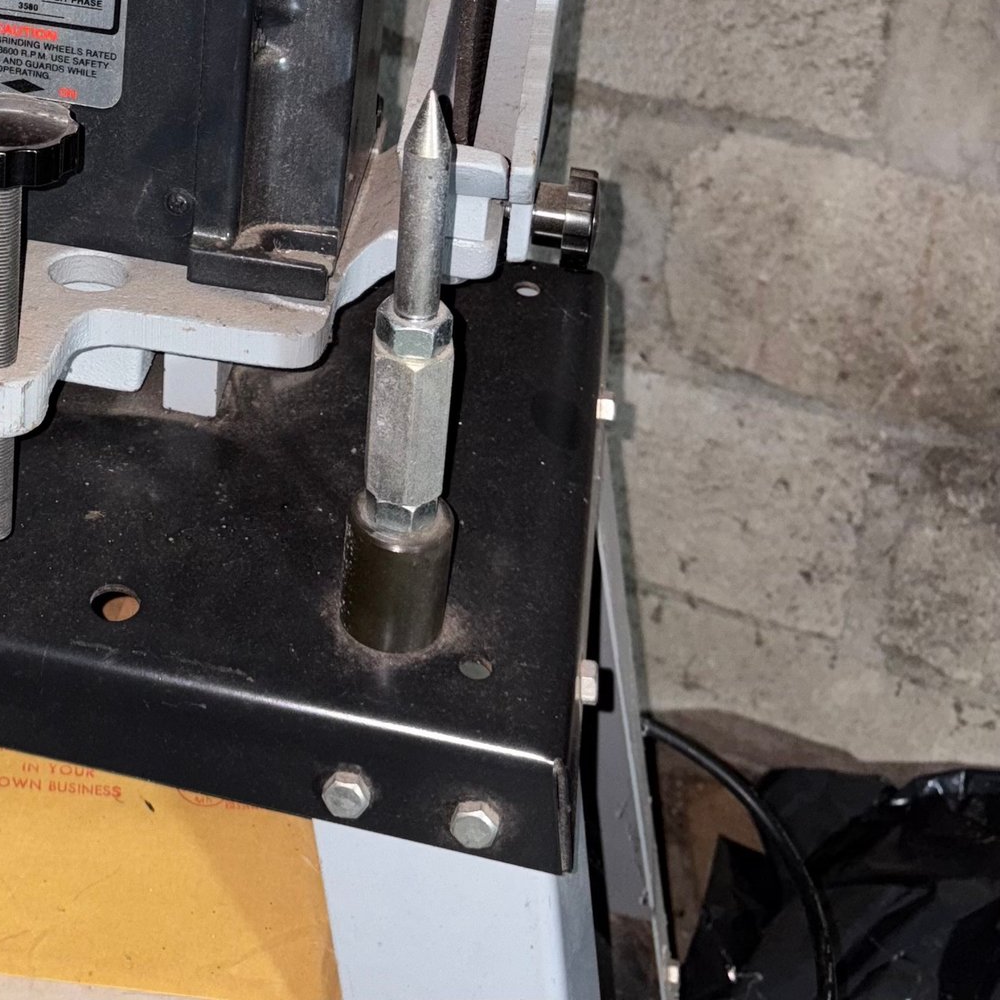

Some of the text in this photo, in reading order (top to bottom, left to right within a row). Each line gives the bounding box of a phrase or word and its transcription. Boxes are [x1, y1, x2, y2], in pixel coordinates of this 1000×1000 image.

[18, 2, 39, 12] 3580
[43, 42, 83, 56] WHEELS
[86, 49, 117, 61] RATED
[3, 56, 23, 66] AND
[25, 60, 65, 73] GUARDS
[67, 66, 97, 78] WHILE
[51, 54, 70, 64] USE
[72, 57, 109, 70] SAFETY
[22, 762, 95, 778] IN YOUR
[48, 780, 122, 798] BUSINESS
